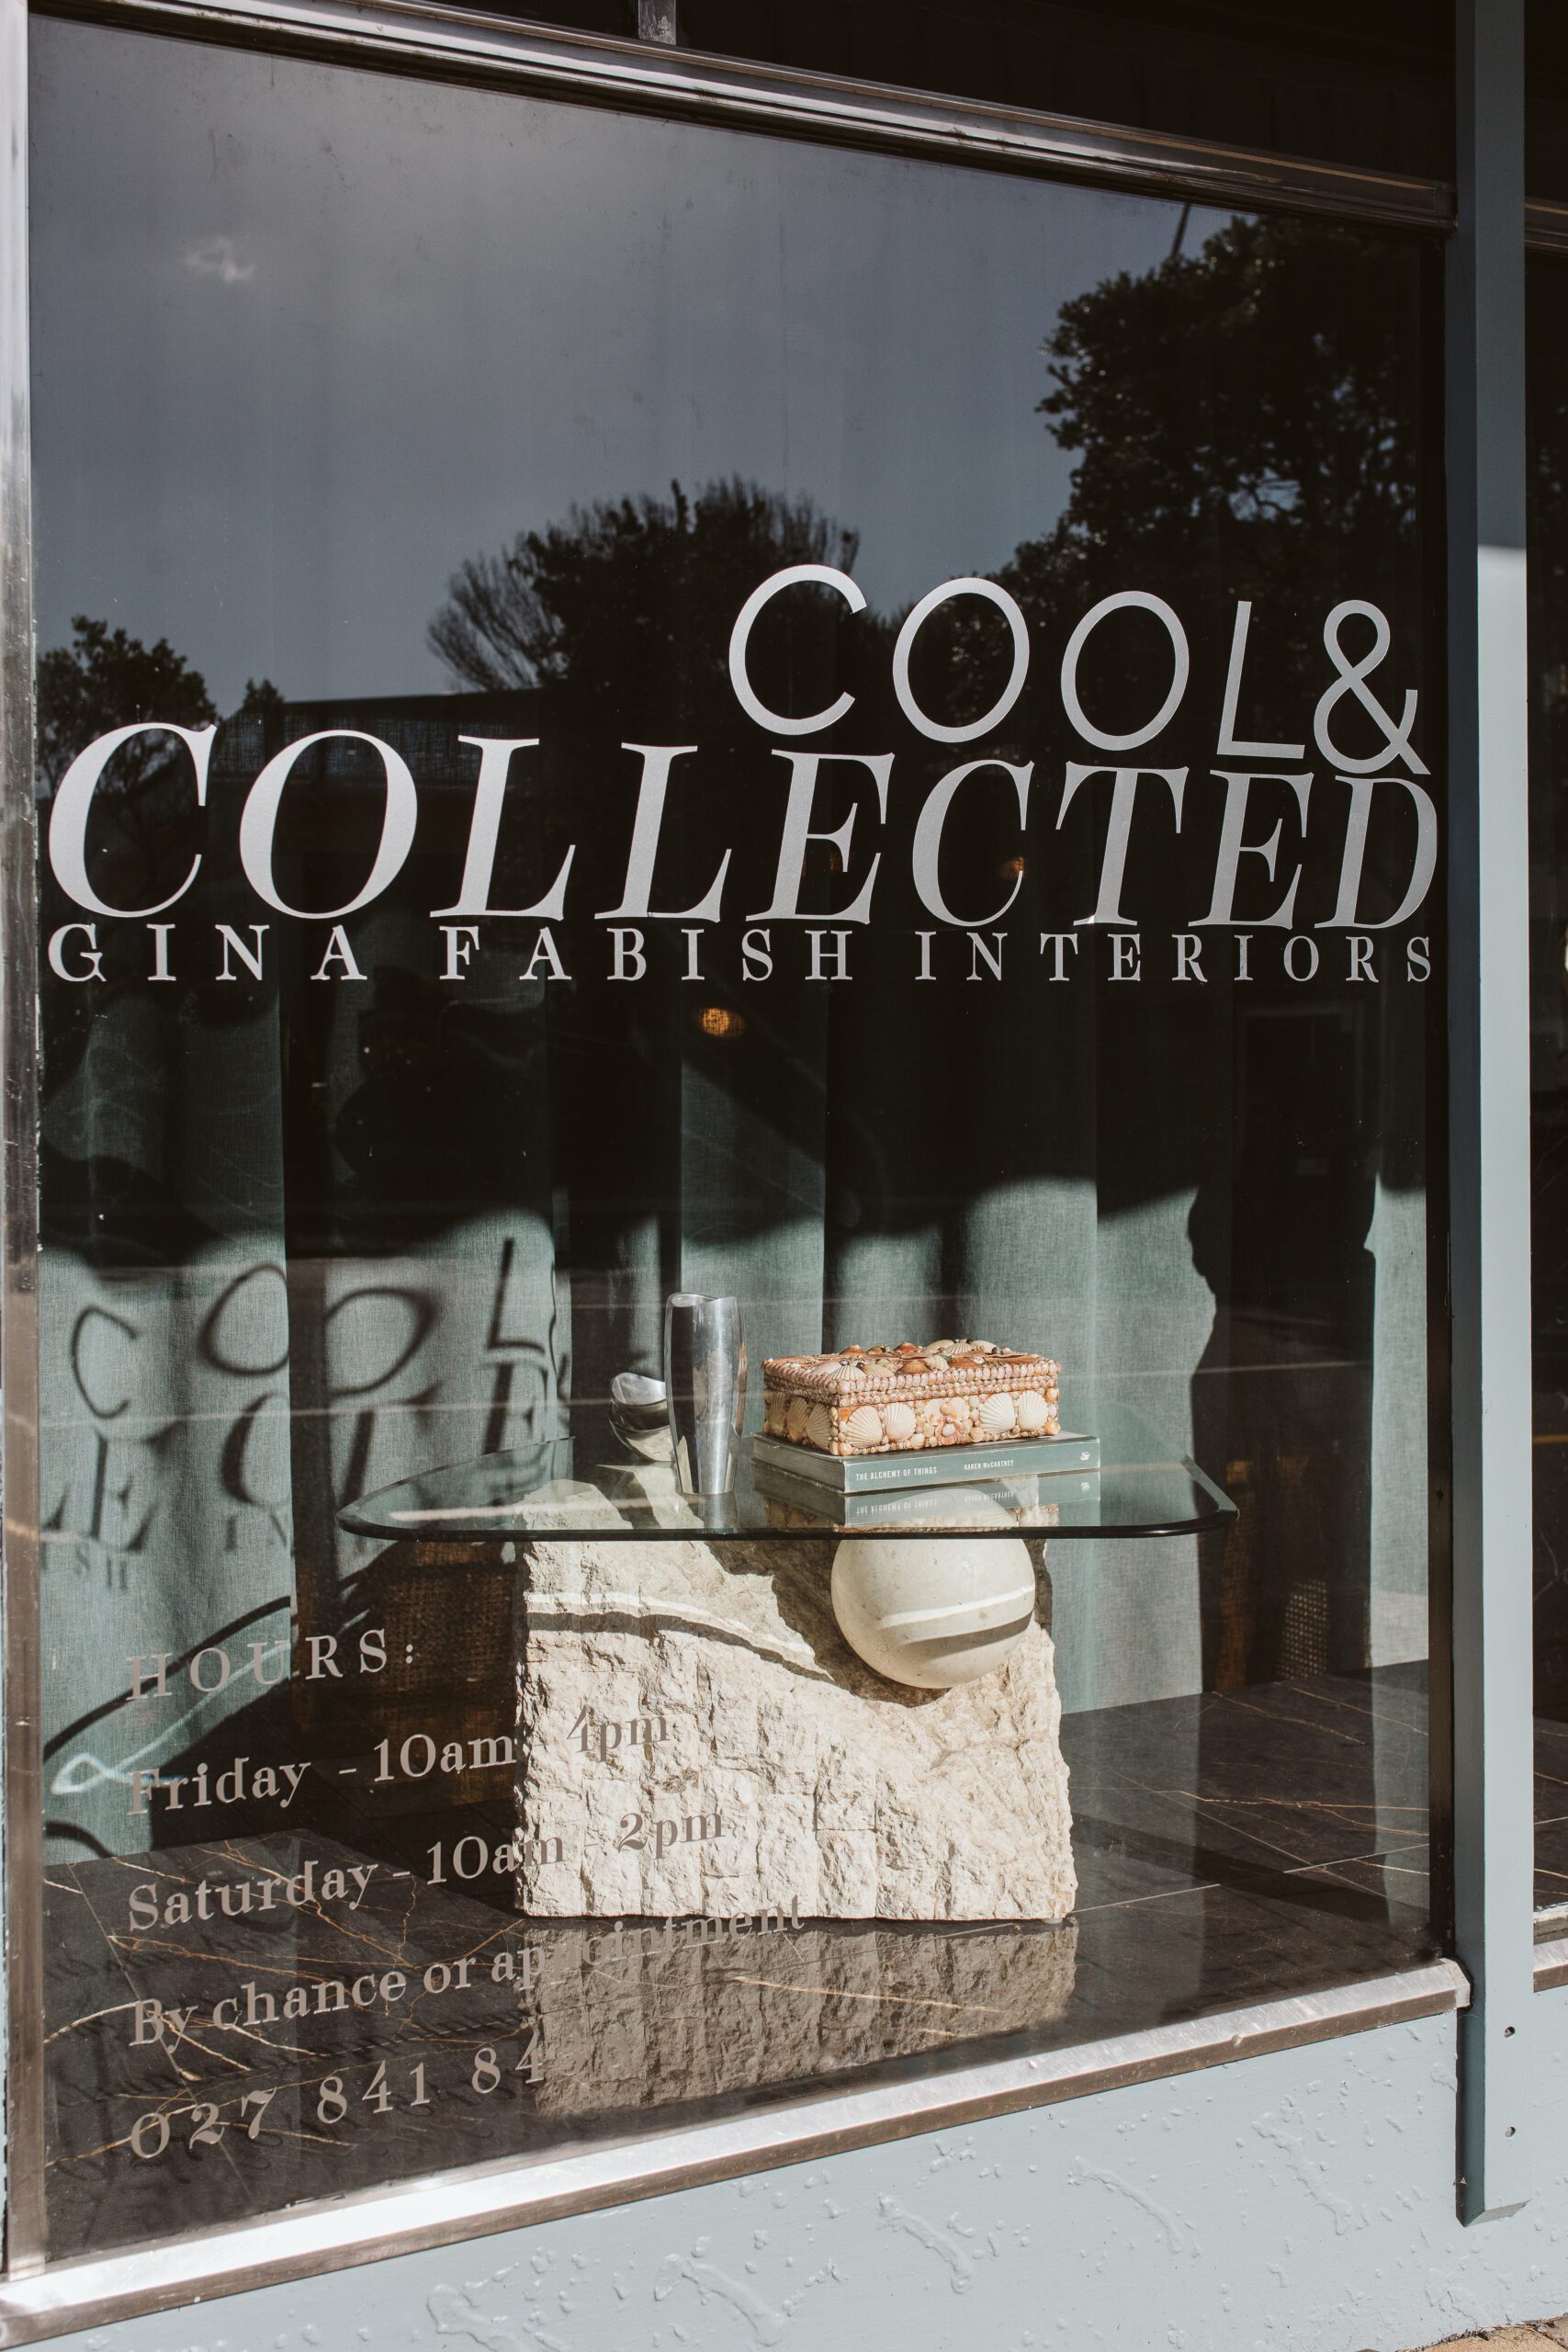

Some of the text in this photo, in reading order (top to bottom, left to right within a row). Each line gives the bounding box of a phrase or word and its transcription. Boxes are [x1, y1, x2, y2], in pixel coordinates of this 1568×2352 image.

[48, 721, 1438, 930] COLLECTED
[47, 922, 1432, 983] GINA FABISH INTERIORS
[855, 1465, 938, 1481] THE ALCHEMY OF THINGS
[964, 1463, 981, 1471] KAREN
[126, 1628, 414, 1701] HOURS:
[127, 1757, 312, 1816] Friday
[372, 1734, 517, 1783] 10am
[566, 1705, 672, 1763] 4pm
[129, 1860, 379, 1932] Saturday
[426, 1836, 566, 1884] 10am
[617, 1812, 727, 1860] 2pm
[129, 1997, 198, 2054] By
[212, 1969, 408, 2031] chance
[423, 1957, 477, 1995] or
[130, 2086, 276, 2159] 027
[316, 2059, 431, 2124] 841
